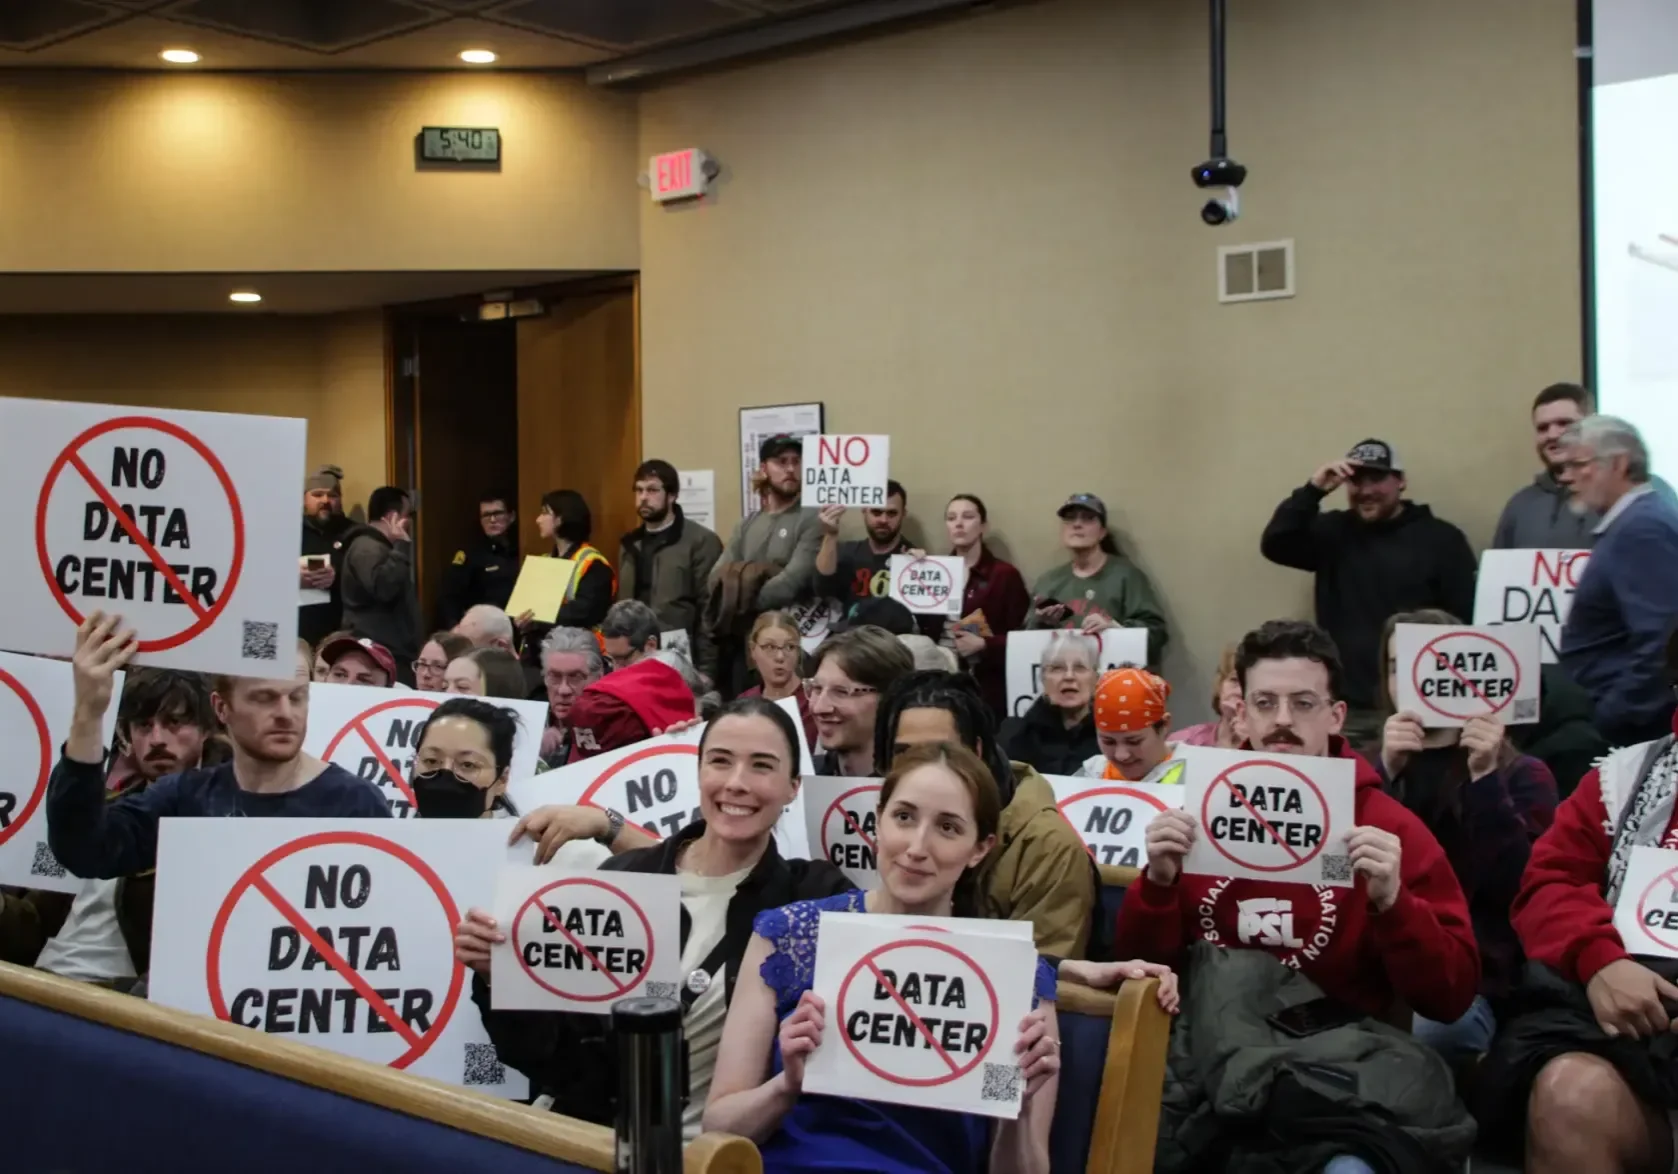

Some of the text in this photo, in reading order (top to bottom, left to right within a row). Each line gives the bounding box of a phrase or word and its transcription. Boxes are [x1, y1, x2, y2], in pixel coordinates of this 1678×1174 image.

[440, 128, 482, 149] 5:40
[657, 152, 692, 192] EXIT
[819, 436, 869, 467] NO
[111, 447, 166, 490] NO
[806, 468, 852, 485] DATA
[816, 487, 884, 505] CENTER
[83, 502, 190, 549] DATA
[56, 555, 217, 607] CENTER
[902, 584, 949, 596] CENTER
[909, 570, 941, 581] DATA
[1435, 652, 1498, 672] DATA
[1420, 678, 1514, 698] CENTER
[626, 768, 677, 813] NO
[1229, 783, 1303, 814] DATA
[1084, 805, 1133, 835] NO
[1211, 816, 1321, 848] CENTER
[304, 864, 371, 909] NO
[542, 905, 625, 938] DATA
[268, 926, 400, 971] DATA
[523, 942, 645, 974] CENTER
[874, 969, 966, 1009] DATA
[230, 988, 433, 1034] CENTER
[847, 1010, 988, 1054] CENTER
